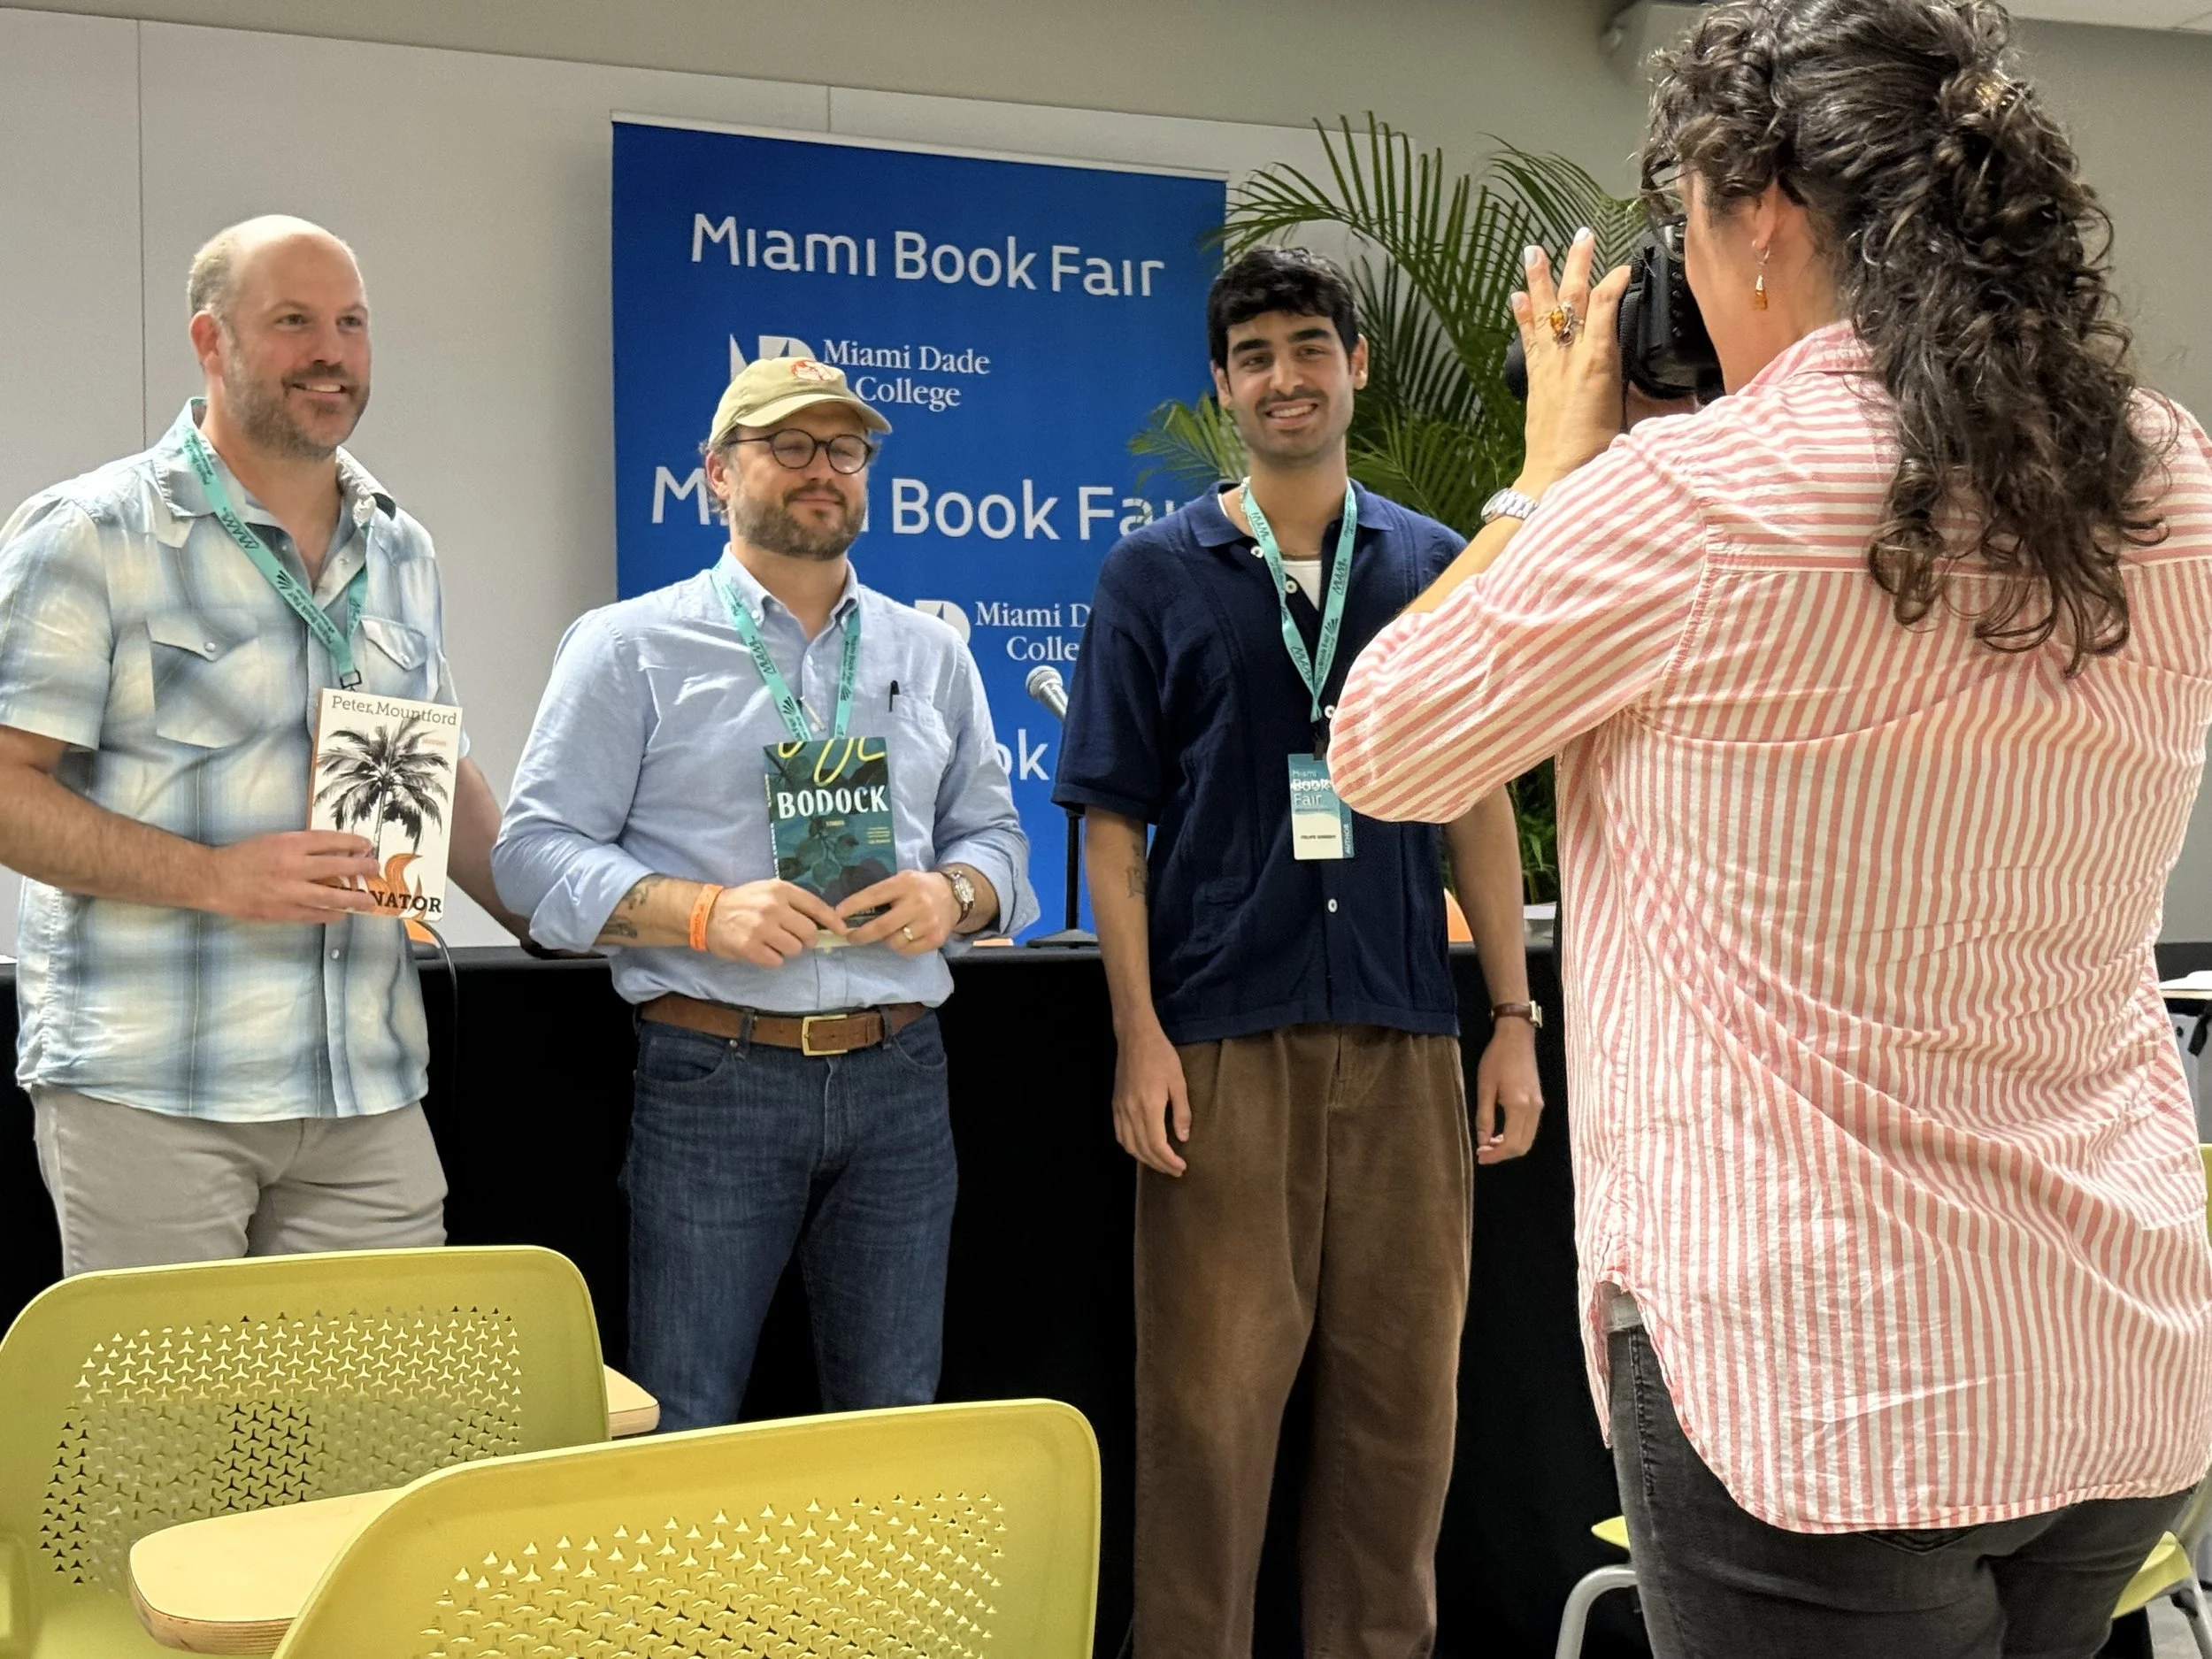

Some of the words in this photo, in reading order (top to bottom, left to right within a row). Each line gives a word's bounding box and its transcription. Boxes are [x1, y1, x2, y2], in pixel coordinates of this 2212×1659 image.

[691, 213, 877, 277] Miami
[895, 231, 1037, 289] Book
[1052, 245, 1164, 296] Fair
[823, 339, 911, 369] Miami
[918, 345, 991, 375] Dade
[855, 376, 962, 412] College
[892, 478, 1061, 539] Book
[975, 602, 1063, 627] Miami
[1006, 635, 1080, 661] Colle
[331, 695, 372, 714] Peter
[375, 702, 457, 726] Mountford
[777, 785, 889, 819] BODOCK
[1294, 793, 1322, 806] Fair
